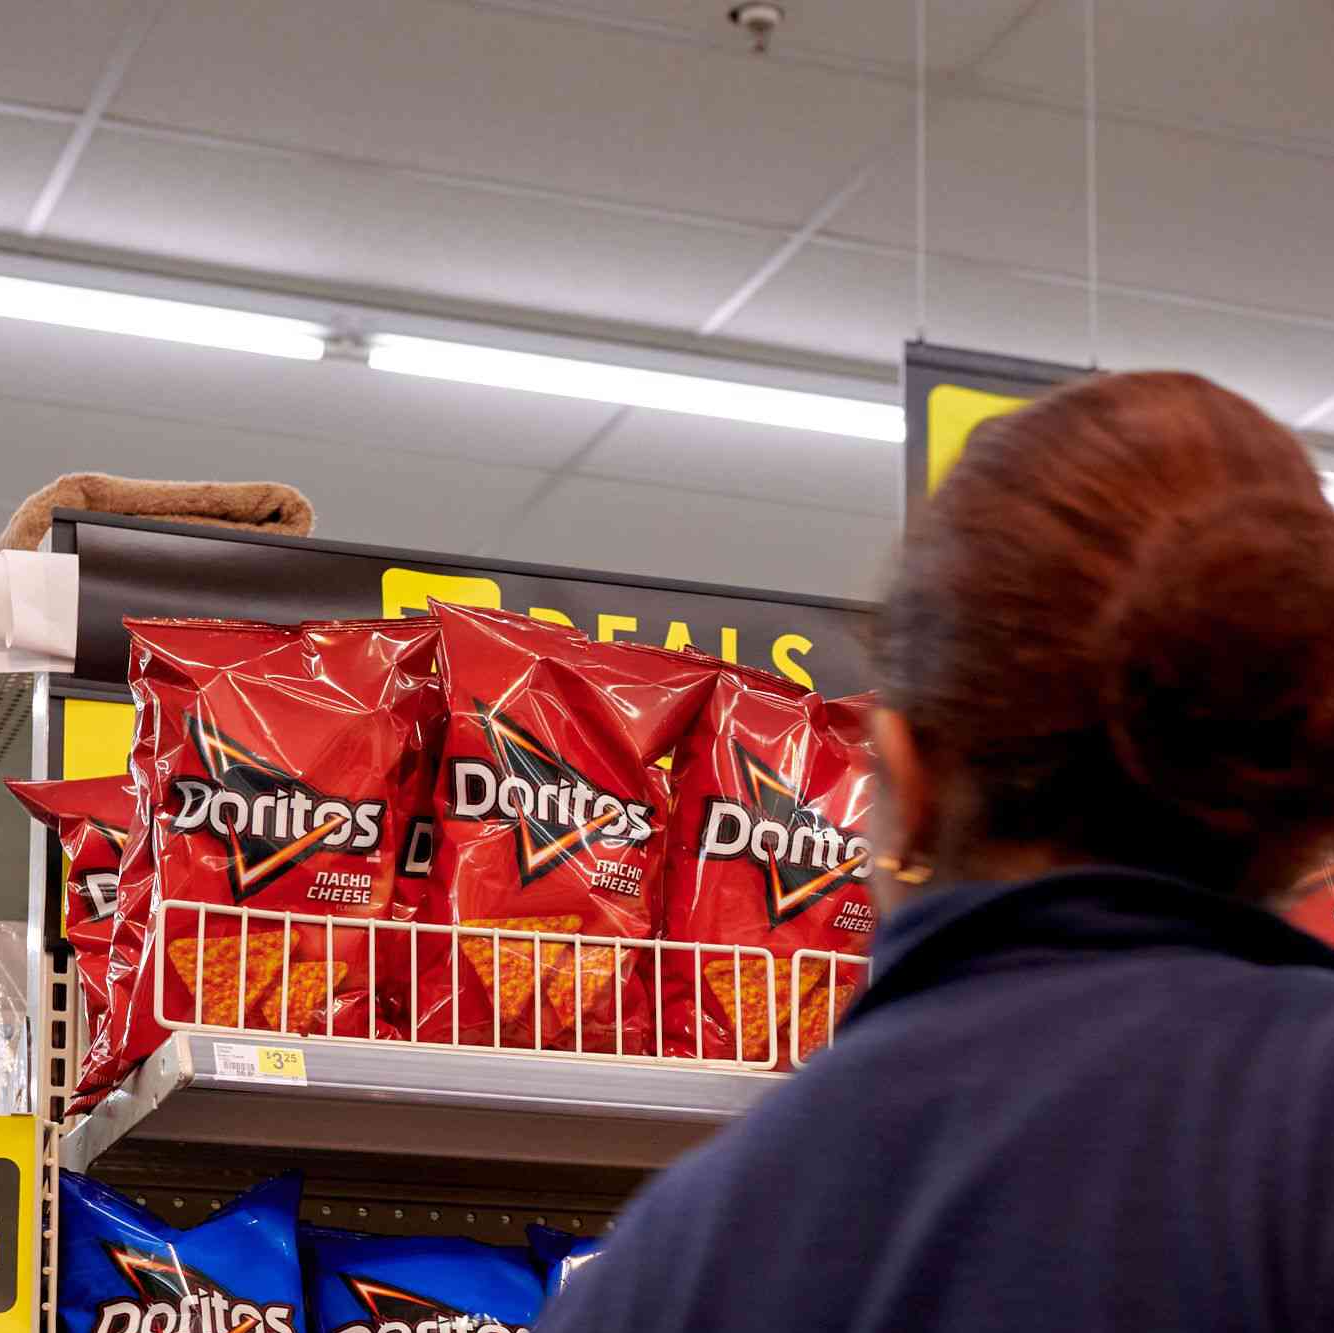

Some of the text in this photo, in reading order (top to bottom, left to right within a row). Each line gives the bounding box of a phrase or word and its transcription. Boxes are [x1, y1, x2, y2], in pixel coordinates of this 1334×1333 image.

[453, 761, 653, 841] Doritos
[174, 780, 385, 850] Doritos
[704, 800, 875, 880] Dorito
[315, 871, 372, 888] NACHO
[596, 859, 643, 881] NACHO
[306, 886, 372, 904] CHEESE
[590, 874, 642, 897] CHEESE
[842, 901, 874, 919] NACH
